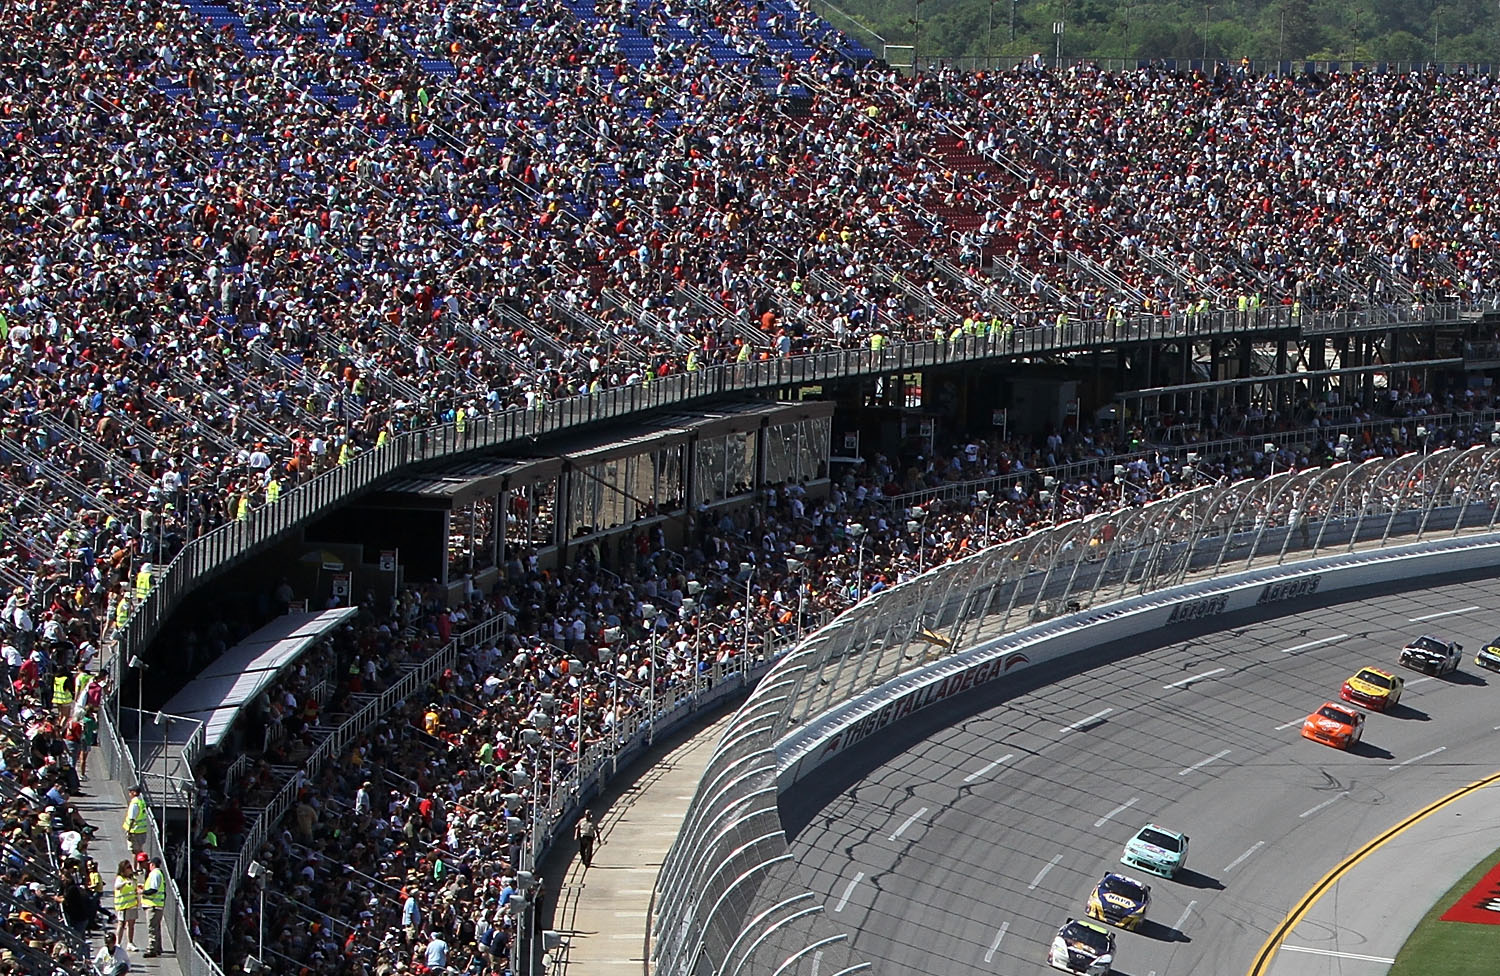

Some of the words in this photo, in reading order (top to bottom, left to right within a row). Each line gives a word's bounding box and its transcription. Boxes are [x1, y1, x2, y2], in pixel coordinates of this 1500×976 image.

[1255, 574, 1322, 606] Aaron's
[1166, 594, 1231, 625] Aaron's
[891, 658, 1001, 723] TALLADEGA
[1107, 893, 1133, 907] NAPA
